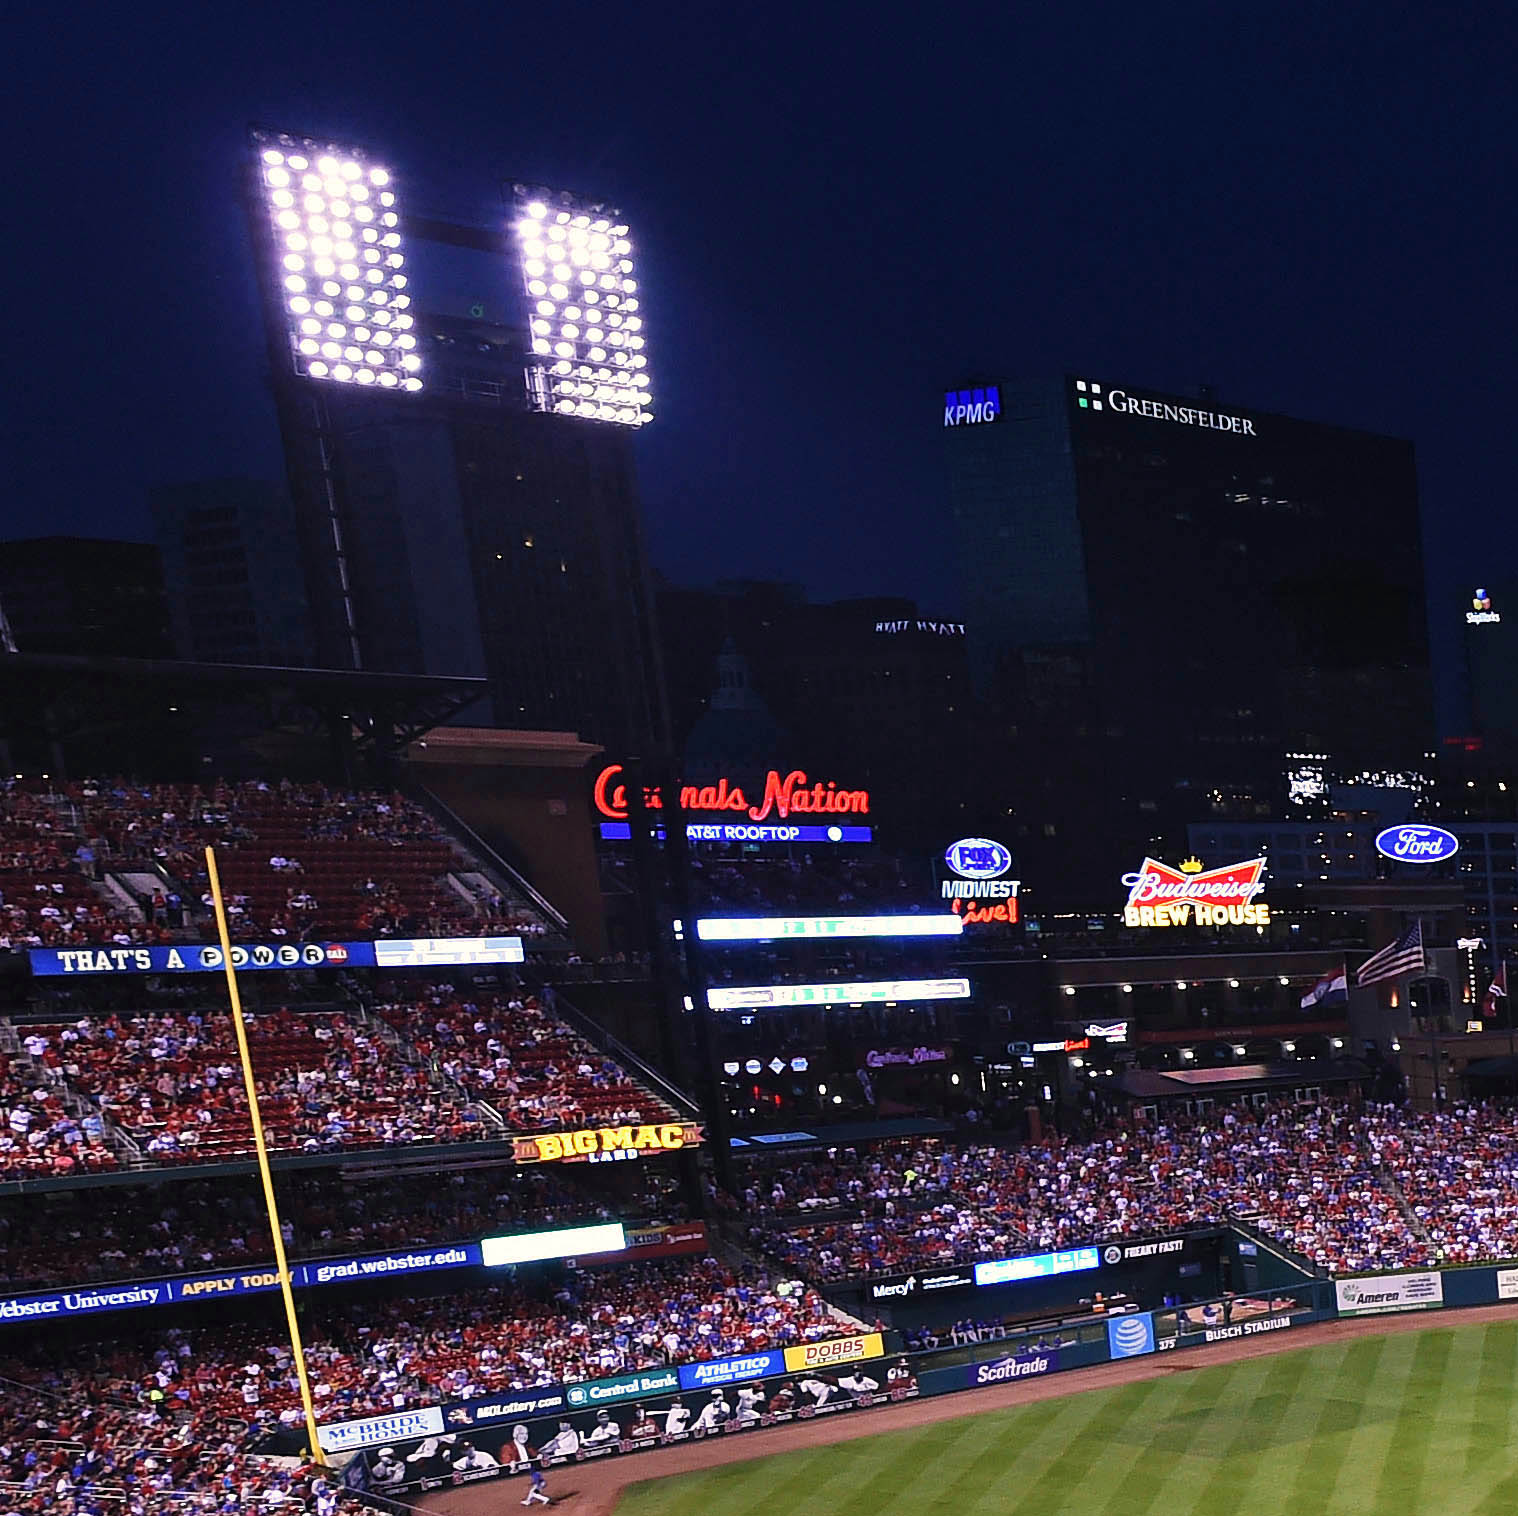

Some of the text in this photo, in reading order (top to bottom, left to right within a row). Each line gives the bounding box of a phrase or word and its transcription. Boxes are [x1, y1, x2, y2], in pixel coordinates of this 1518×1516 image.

[944, 401, 995, 426] KPMG
[875, 620, 910, 634] HYATT
[916, 620, 966, 635] HYATT
[748, 770, 869, 820] Nation
[686, 825, 800, 840] AT&T ROOFTOP
[1393, 830, 1444, 857] Ford
[941, 880, 1021, 898] MIDWEST
[1121, 872, 1266, 902] Budweiser
[1124, 903, 1270, 927] BREW HOUSE
[57, 945, 320, 971] THAT'S A POWER
[535, 1124, 684, 1161] BIG MAC
[588, 1148, 639, 1164] LAND
[62, 1285, 159, 1311] University
[181, 1278, 236, 1296] APPLY
[316, 1246, 467, 1282] grad.webster.edu
[873, 1283, 908, 1298] Mercy
[1356, 1291, 1400, 1305] Ameren
[1205, 1317, 1291, 1342] BUSCH STADIUM
[805, 1339, 864, 1359] DOBBS
[695, 1356, 770, 1379] ATHLETICO
[976, 1356, 1049, 1385] Scottrade
[590, 1374, 678, 1399] Central Bank
[360, 1424, 430, 1443] HOMES
